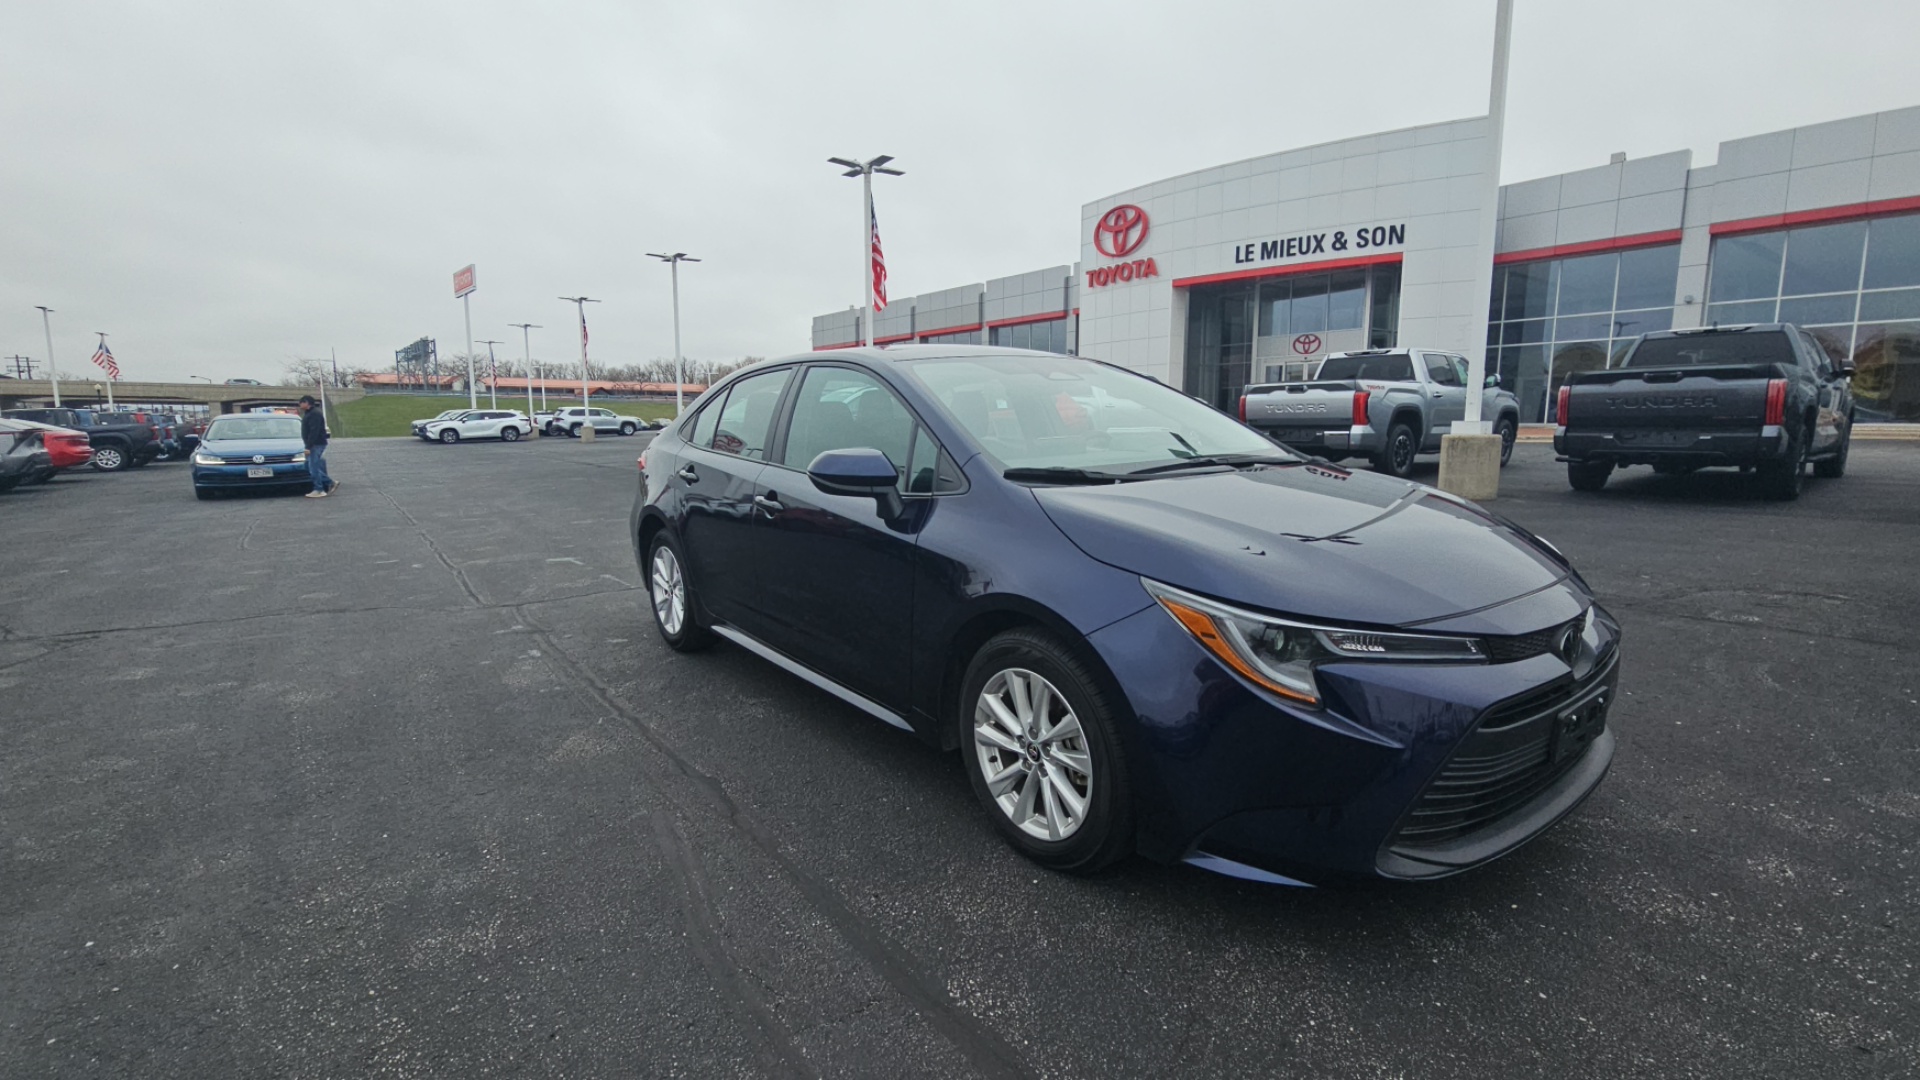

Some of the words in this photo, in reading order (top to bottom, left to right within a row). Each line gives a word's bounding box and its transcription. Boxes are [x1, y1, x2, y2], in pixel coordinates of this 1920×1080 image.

[1235, 243, 1255, 264] LE
[1260, 233, 1326, 261] MIEUX
[1332, 230, 1348, 251] &
[1357, 224, 1406, 248] SON
[1086, 257, 1158, 288] TOYOTA
[1265, 403, 1327, 414] TUNDRA
[1606, 396, 1718, 409] TUNDRA
